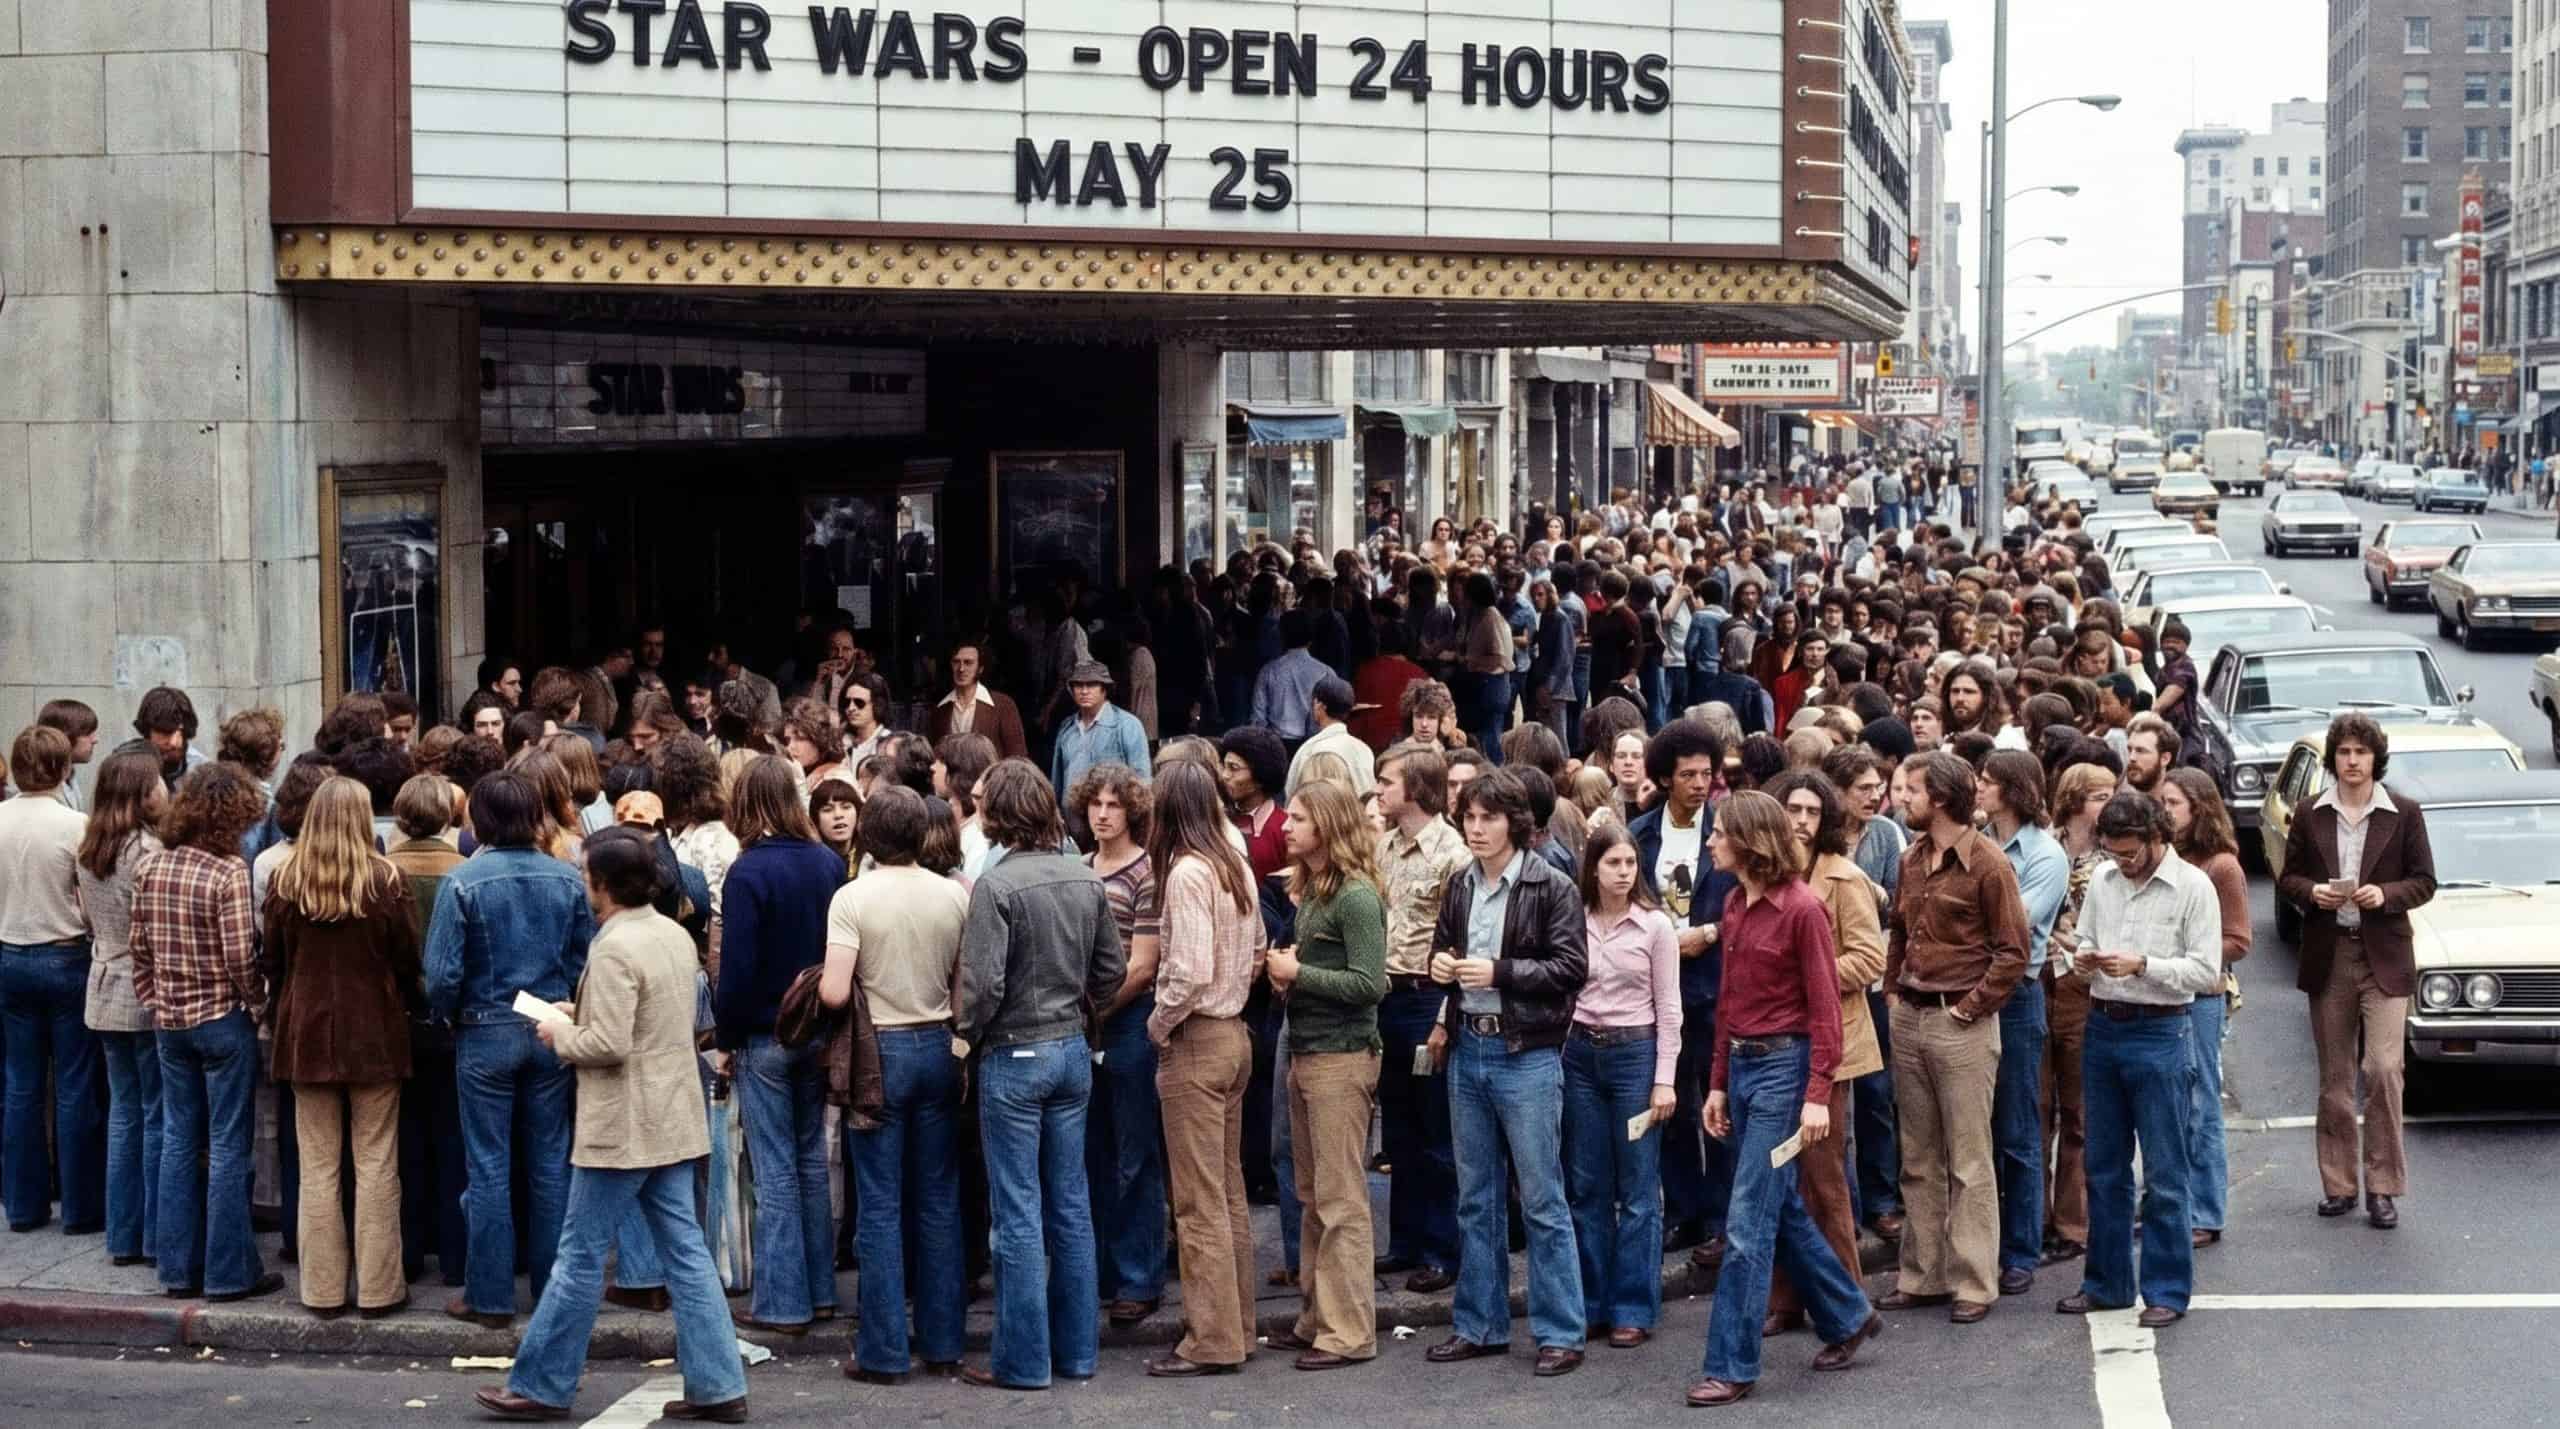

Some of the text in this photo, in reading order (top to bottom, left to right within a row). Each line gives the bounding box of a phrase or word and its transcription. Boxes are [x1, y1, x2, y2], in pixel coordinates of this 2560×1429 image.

[564, 0, 772, 71] STAR
[807, 6, 1028, 84] WARS
[1138, 25, 1317, 98] OPEN
[1348, 37, 1433, 103] 24
[1461, 43, 1671, 115] HOURS
[1015, 138, 1293, 213] MAY 25
